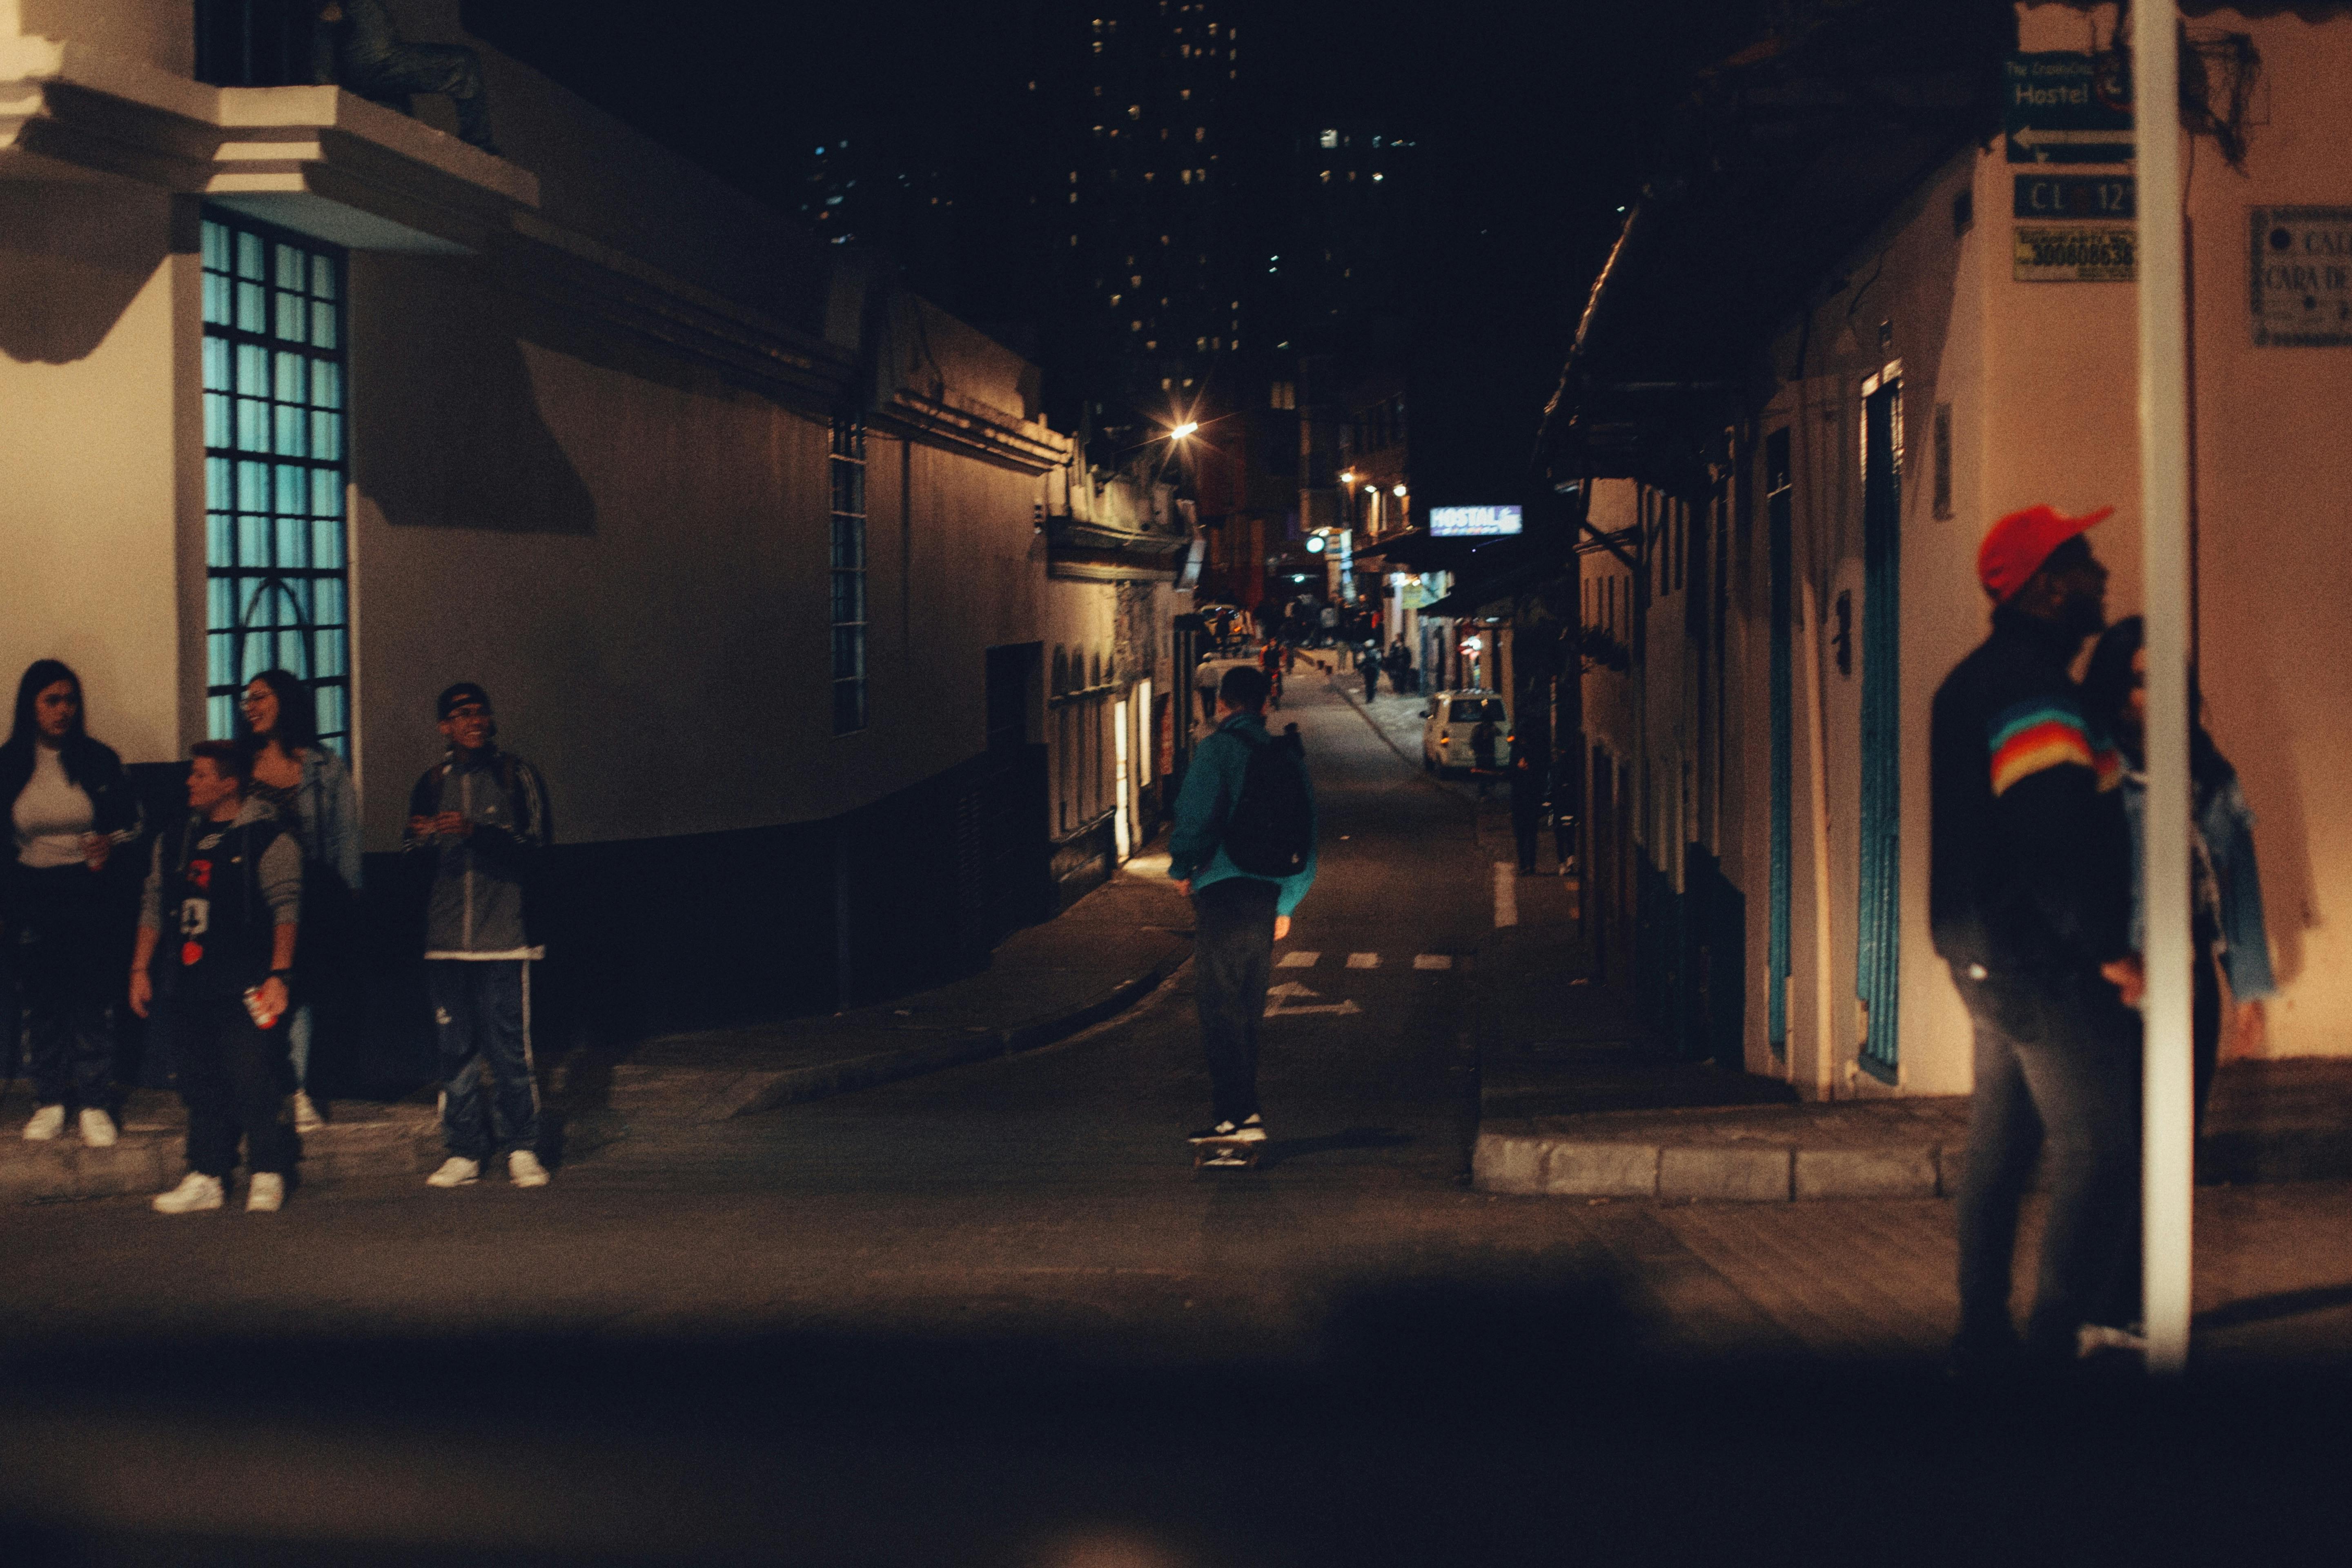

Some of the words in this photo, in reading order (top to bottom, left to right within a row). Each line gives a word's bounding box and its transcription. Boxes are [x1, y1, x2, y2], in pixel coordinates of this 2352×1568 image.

[2015, 82, 2089, 105] Hostel
[2031, 182, 2065, 210] CL
[2265, 265, 2319, 291] CARA
[1432, 508, 1499, 527] HOSTAL
